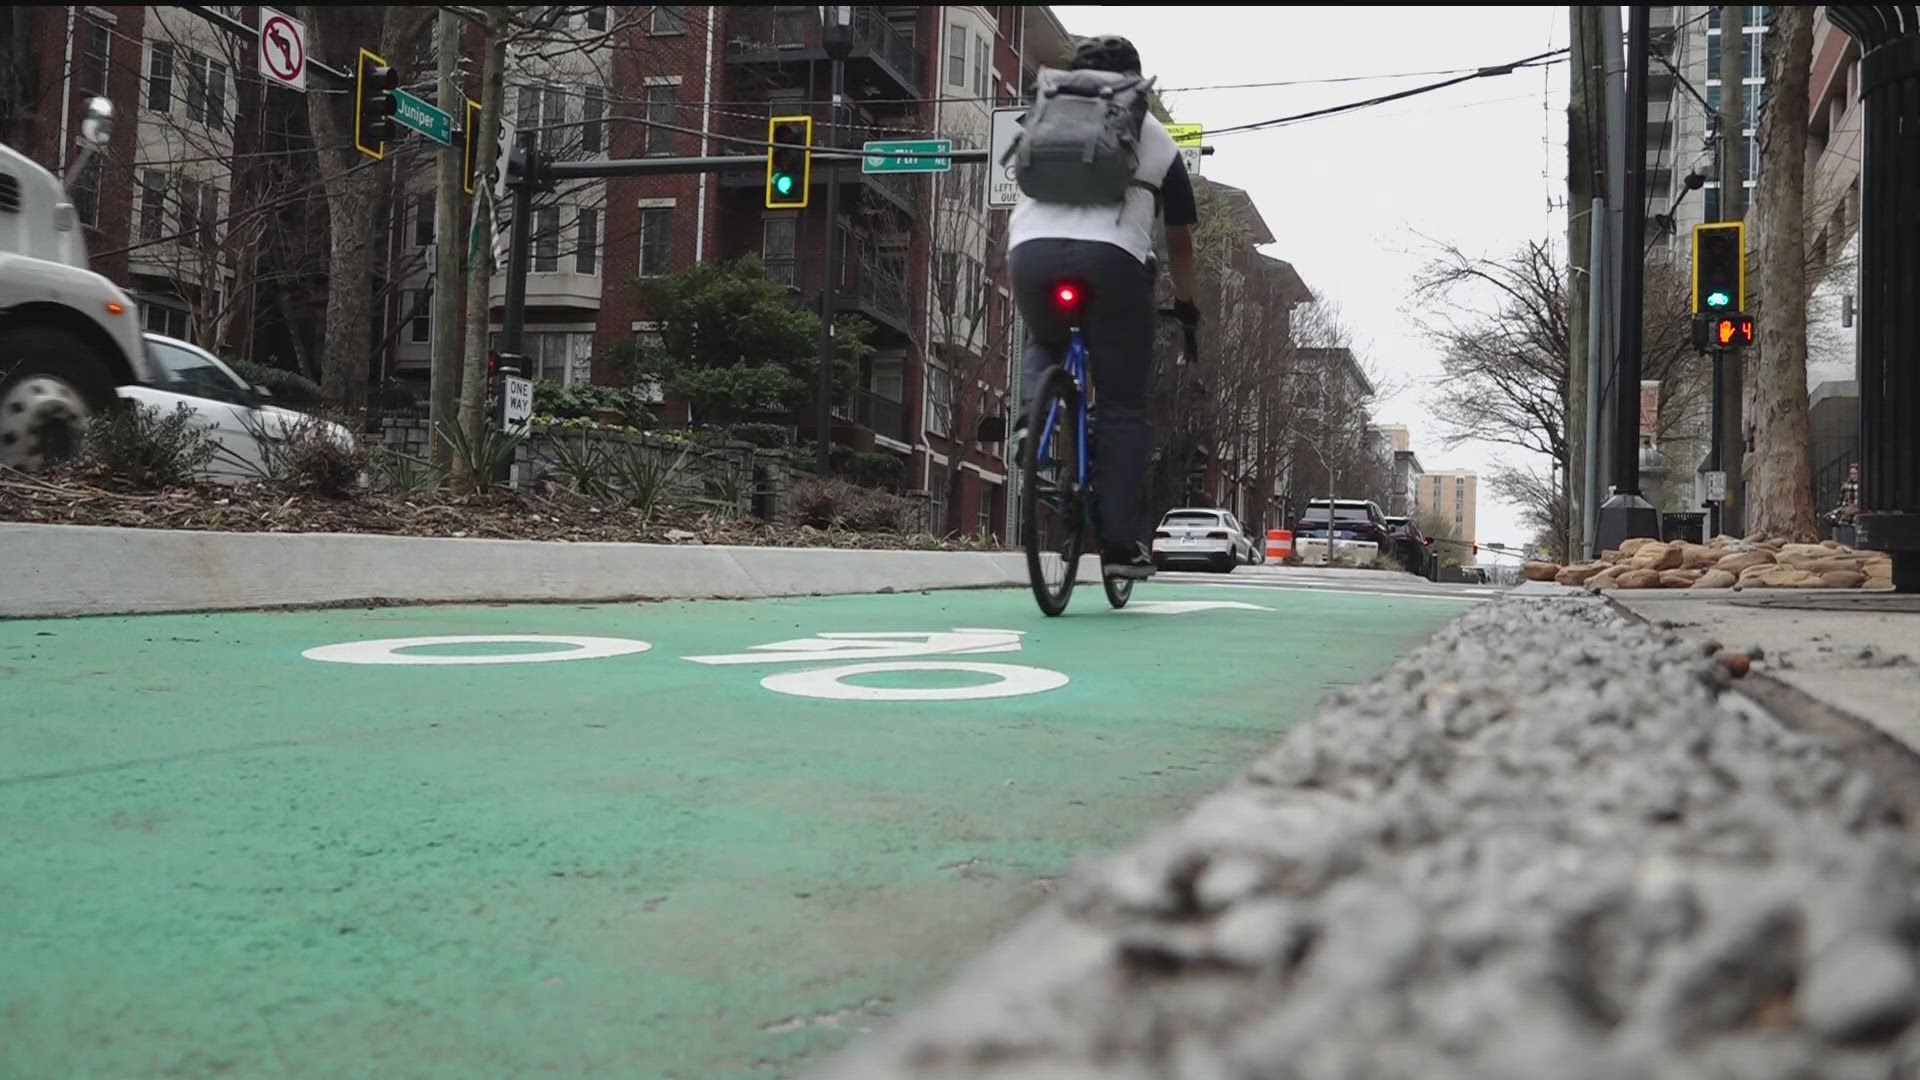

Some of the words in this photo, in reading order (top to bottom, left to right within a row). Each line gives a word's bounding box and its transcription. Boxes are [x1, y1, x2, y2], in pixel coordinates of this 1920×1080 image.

[397, 99, 434, 128] Juniper
[937, 144, 946, 154] St
[935, 156, 947, 166] NE
[994, 183, 1013, 192] LEFT
[1000, 193, 1020, 202] QUE
[1742, 321, 1752, 341] 4
[510, 380, 529, 397] ONE
[510, 397, 529, 412] WAY
